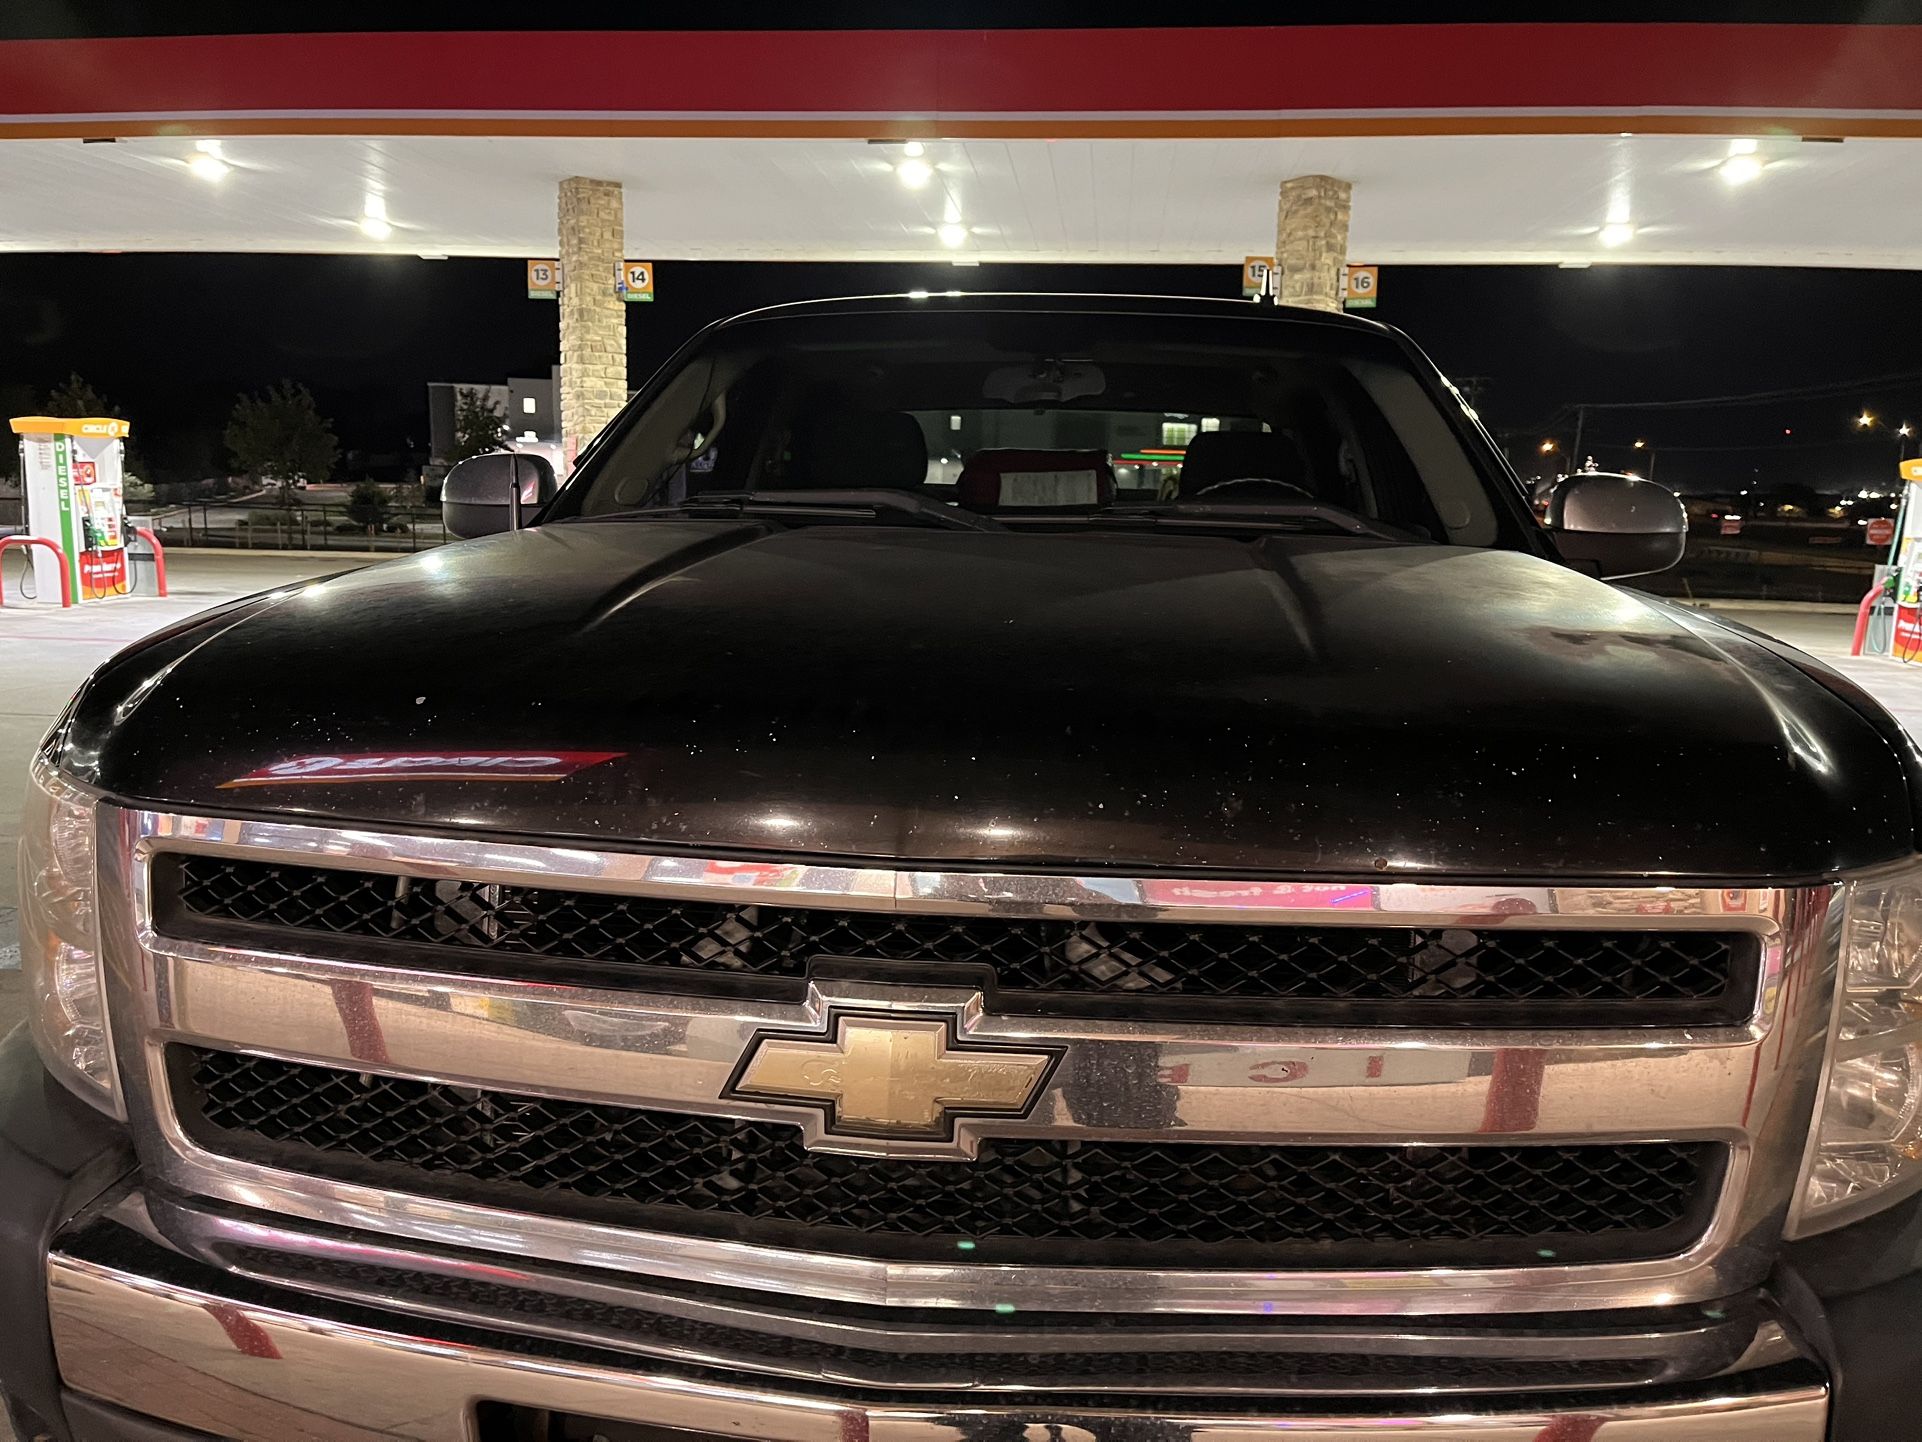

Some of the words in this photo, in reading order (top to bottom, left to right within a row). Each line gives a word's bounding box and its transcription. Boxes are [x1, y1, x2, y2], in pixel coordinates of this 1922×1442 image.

[533, 268, 549, 281] 13
[629, 270, 646, 283] 14
[1250, 264, 1267, 278] 15
[1353, 276, 1370, 289] 16
[55, 442, 70, 511] DIESEL
